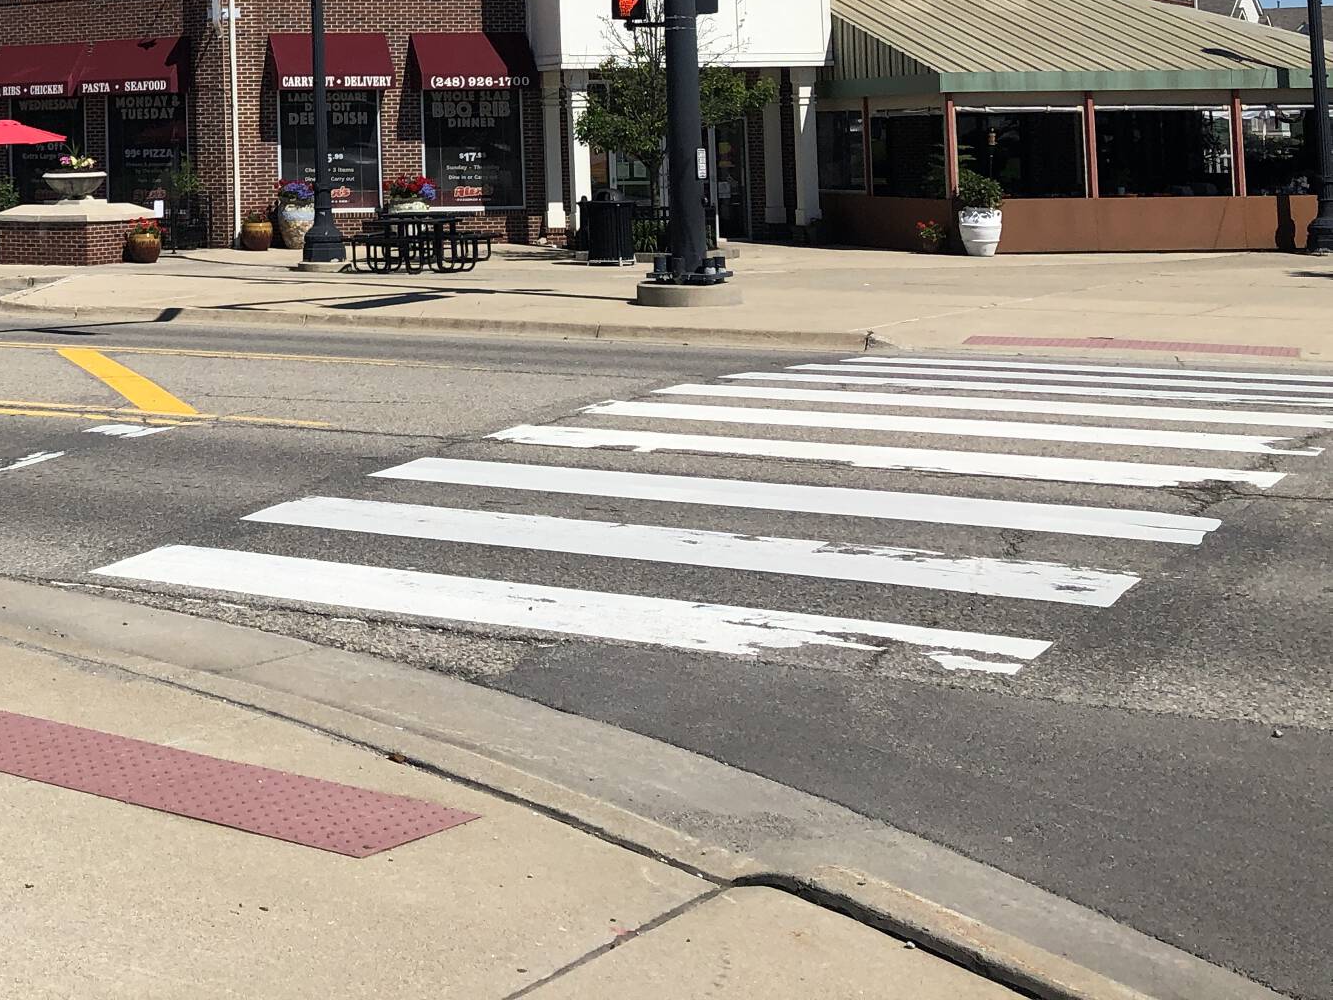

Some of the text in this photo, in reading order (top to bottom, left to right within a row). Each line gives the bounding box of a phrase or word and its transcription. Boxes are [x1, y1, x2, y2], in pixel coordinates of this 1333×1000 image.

[81, 80, 167, 94] PASTA SEAFOOD
[344, 76, 392, 87] DELIVERY
[430, 75, 530, 88] (248) 926-1700
[2, 85, 21, 97] RIBS
[29, 84, 64, 96] CHICKEN
[326, 92, 368, 102] SQUARE
[431, 90, 511, 101] WHOLE SLAB
[18, 98, 79, 111] WEDNESDAY
[115, 95, 167, 109] MONDAY
[120, 107, 175, 120] TUESDAY
[431, 101, 511, 118] BBQ RIB
[332, 112, 368, 125] DISH
[447, 117, 495, 128] DINNER
[142, 148, 174, 158] PIZZA
